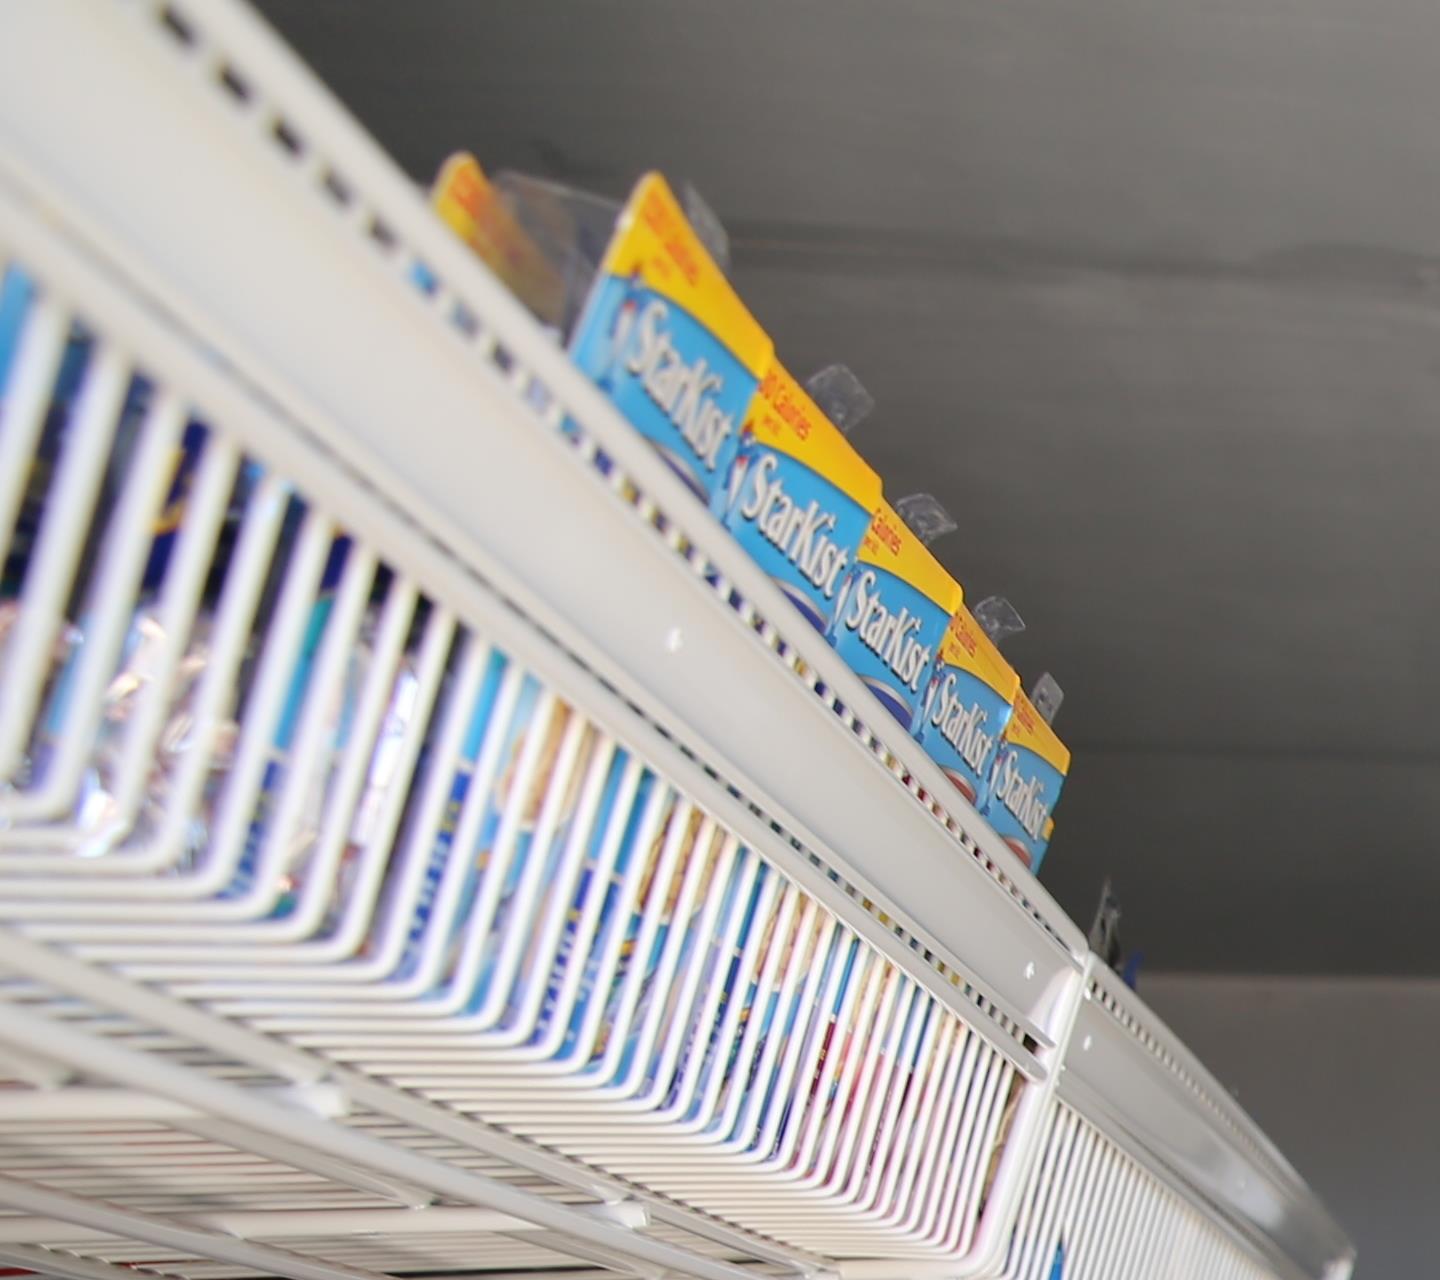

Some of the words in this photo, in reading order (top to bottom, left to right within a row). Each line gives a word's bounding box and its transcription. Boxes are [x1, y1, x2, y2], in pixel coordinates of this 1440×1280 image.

[627, 299, 732, 472] StarKist
[741, 454, 849, 601] StarKist
[845, 570, 931, 693] StarKist
[931, 673, 993, 777] StarKist
[996, 751, 1048, 842] StarKist
